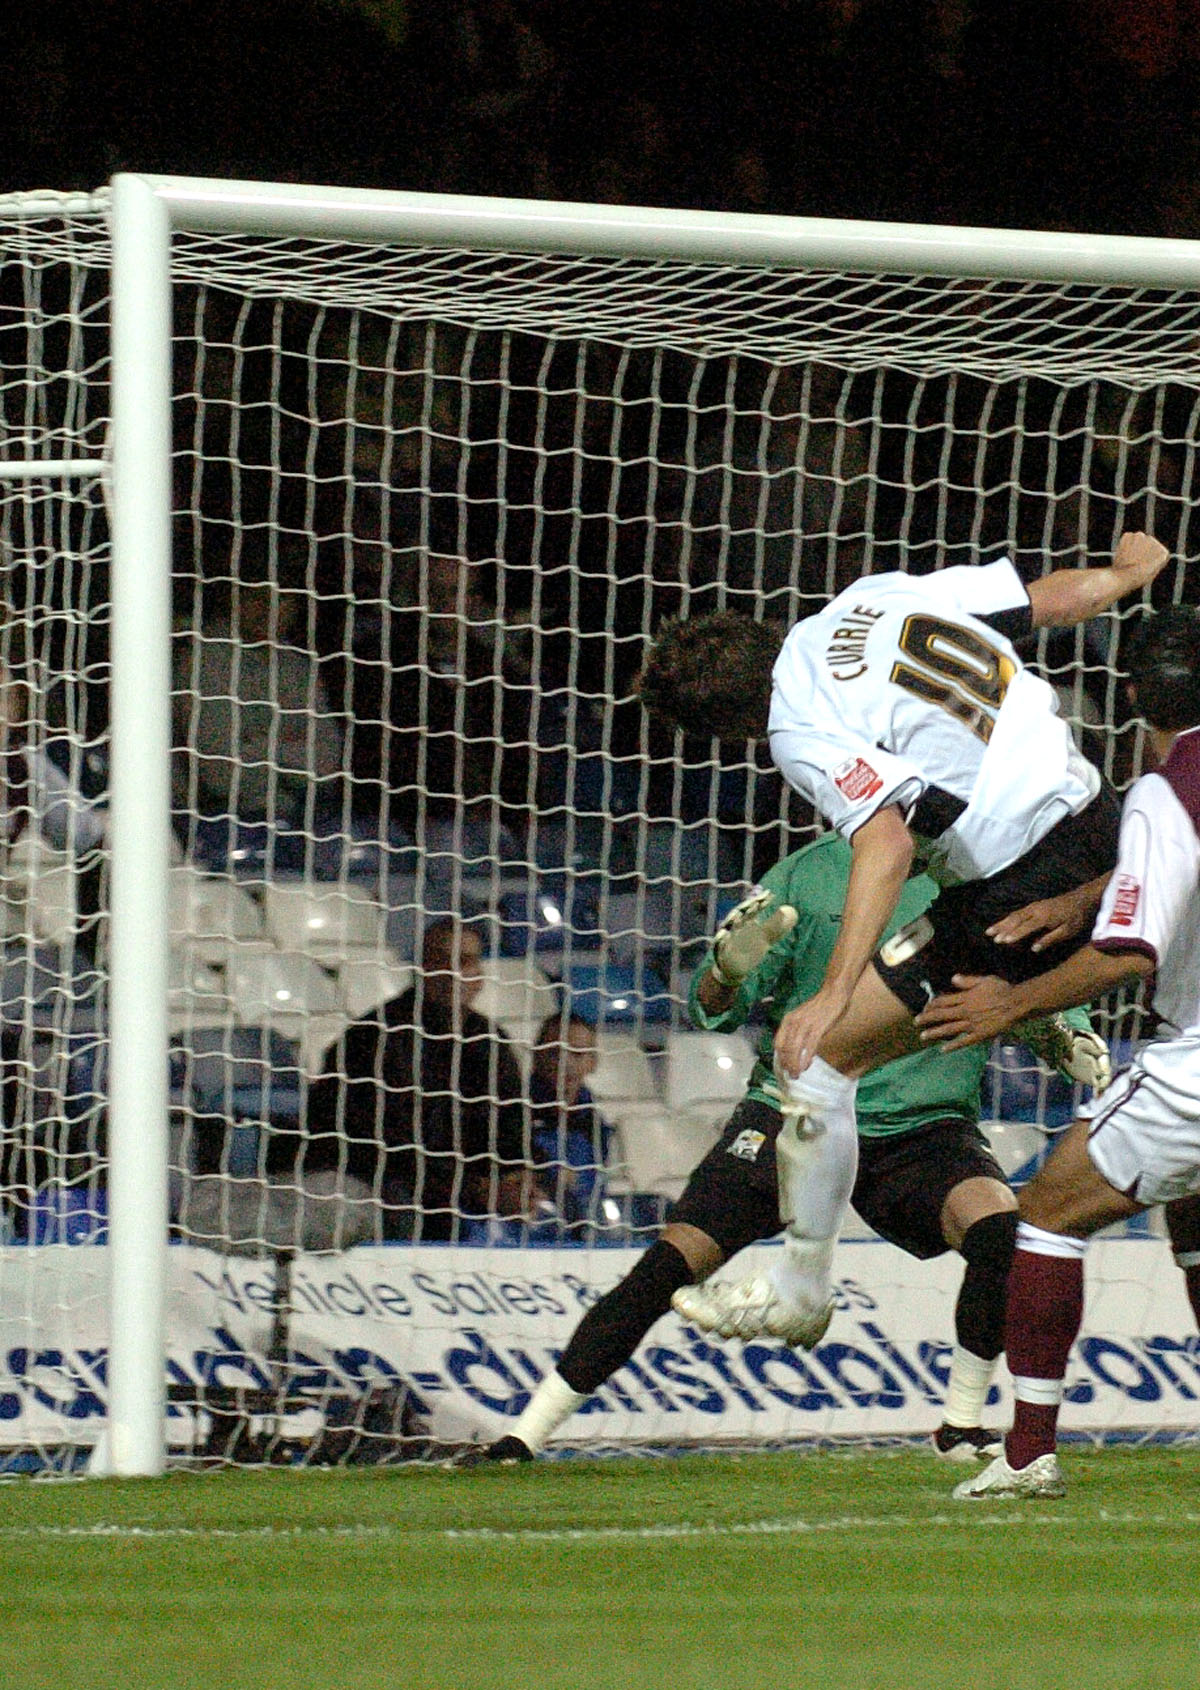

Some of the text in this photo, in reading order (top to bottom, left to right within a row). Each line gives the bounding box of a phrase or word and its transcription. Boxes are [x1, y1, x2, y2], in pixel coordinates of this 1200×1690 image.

[825, 603, 886, 682] CURRIE
[889, 612, 1018, 746] 10
[193, 1270, 412, 1316] Vehicle
[412, 1272, 566, 1315] Sales
